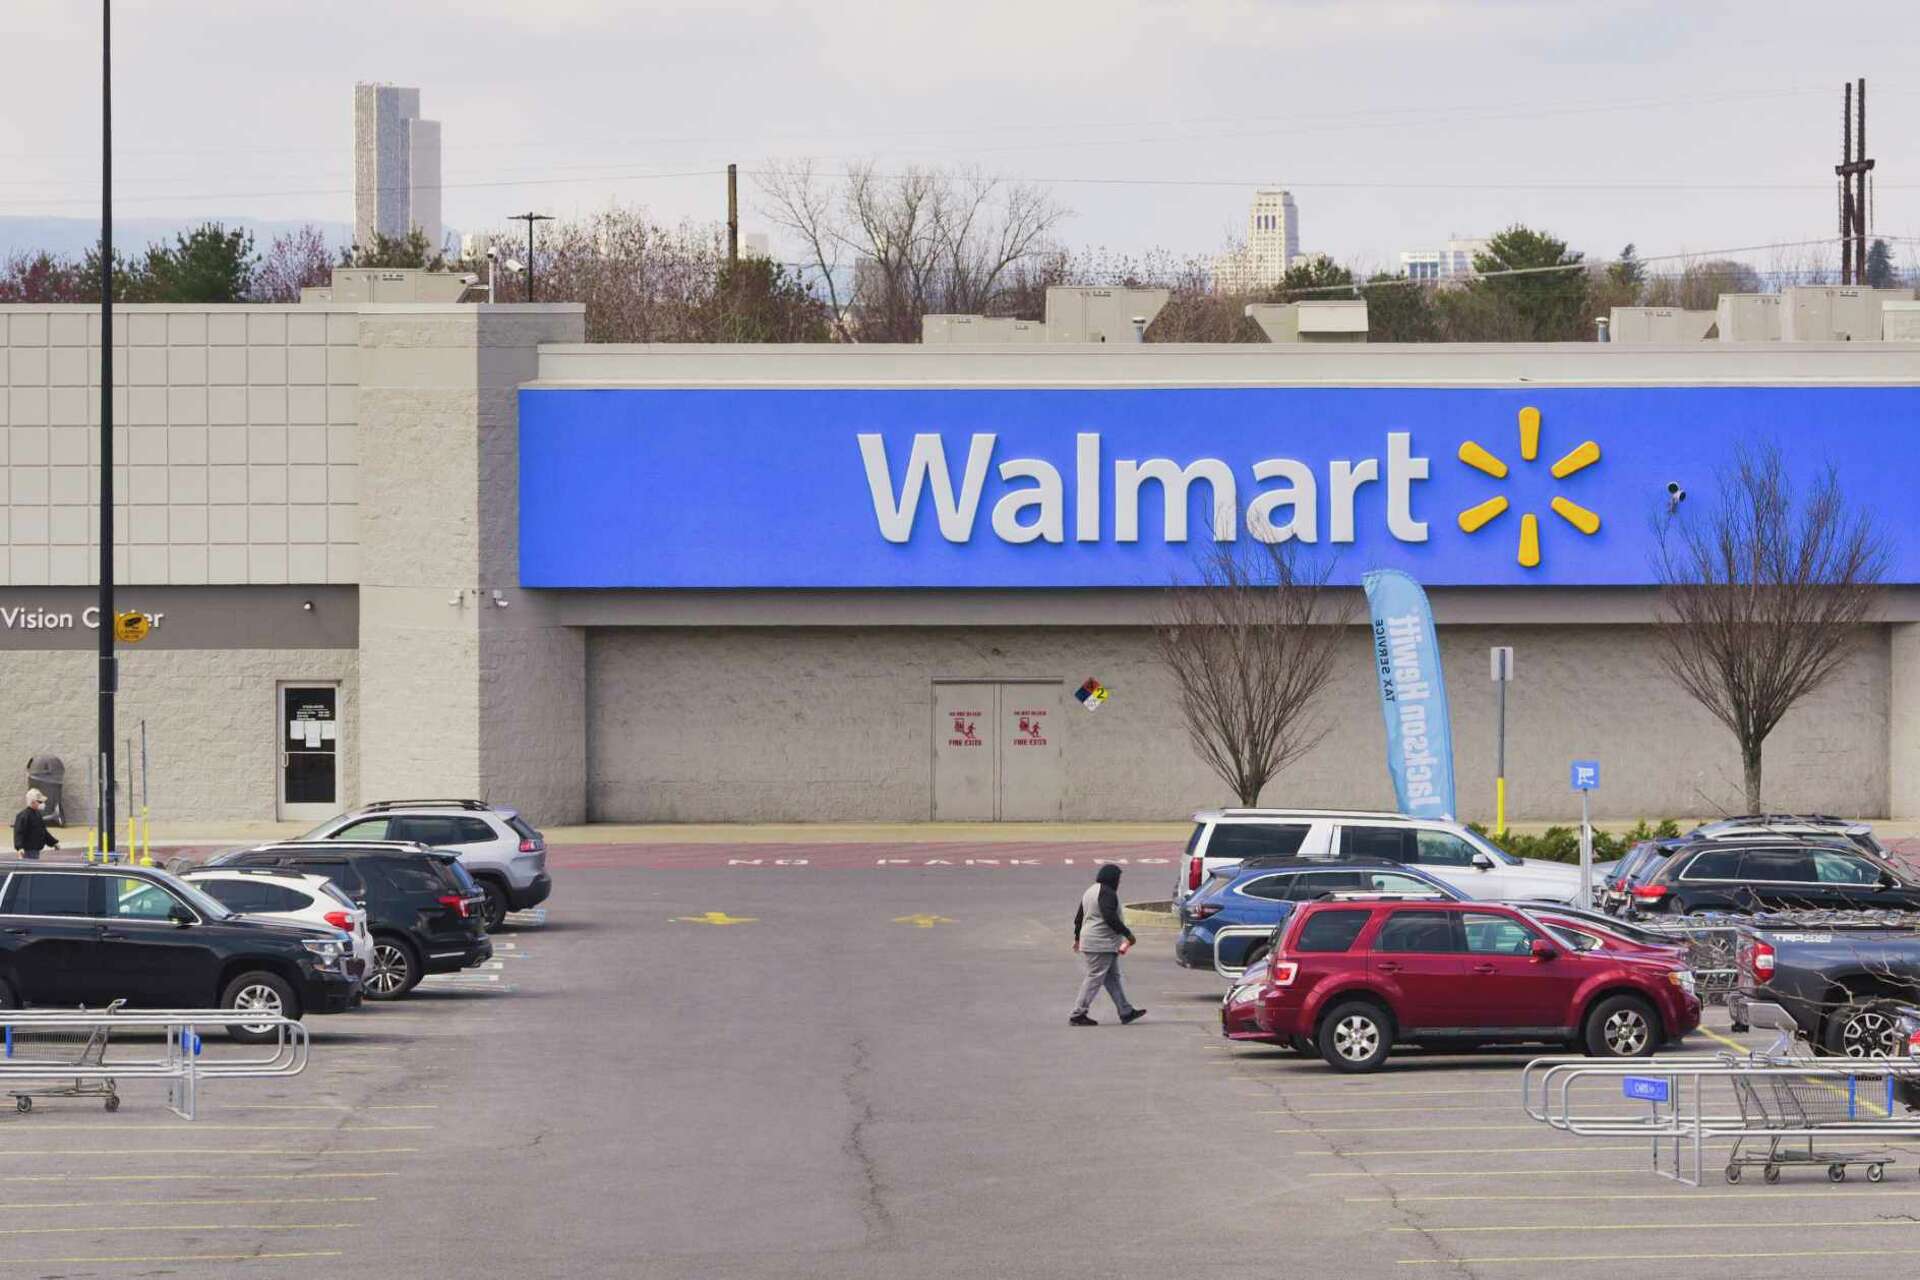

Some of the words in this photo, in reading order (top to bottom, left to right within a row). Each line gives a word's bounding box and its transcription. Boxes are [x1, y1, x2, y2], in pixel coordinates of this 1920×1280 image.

[857, 431, 1429, 544] Walmart
[0, 606, 73, 628] Vision
[1096, 687, 1105, 699] 2
